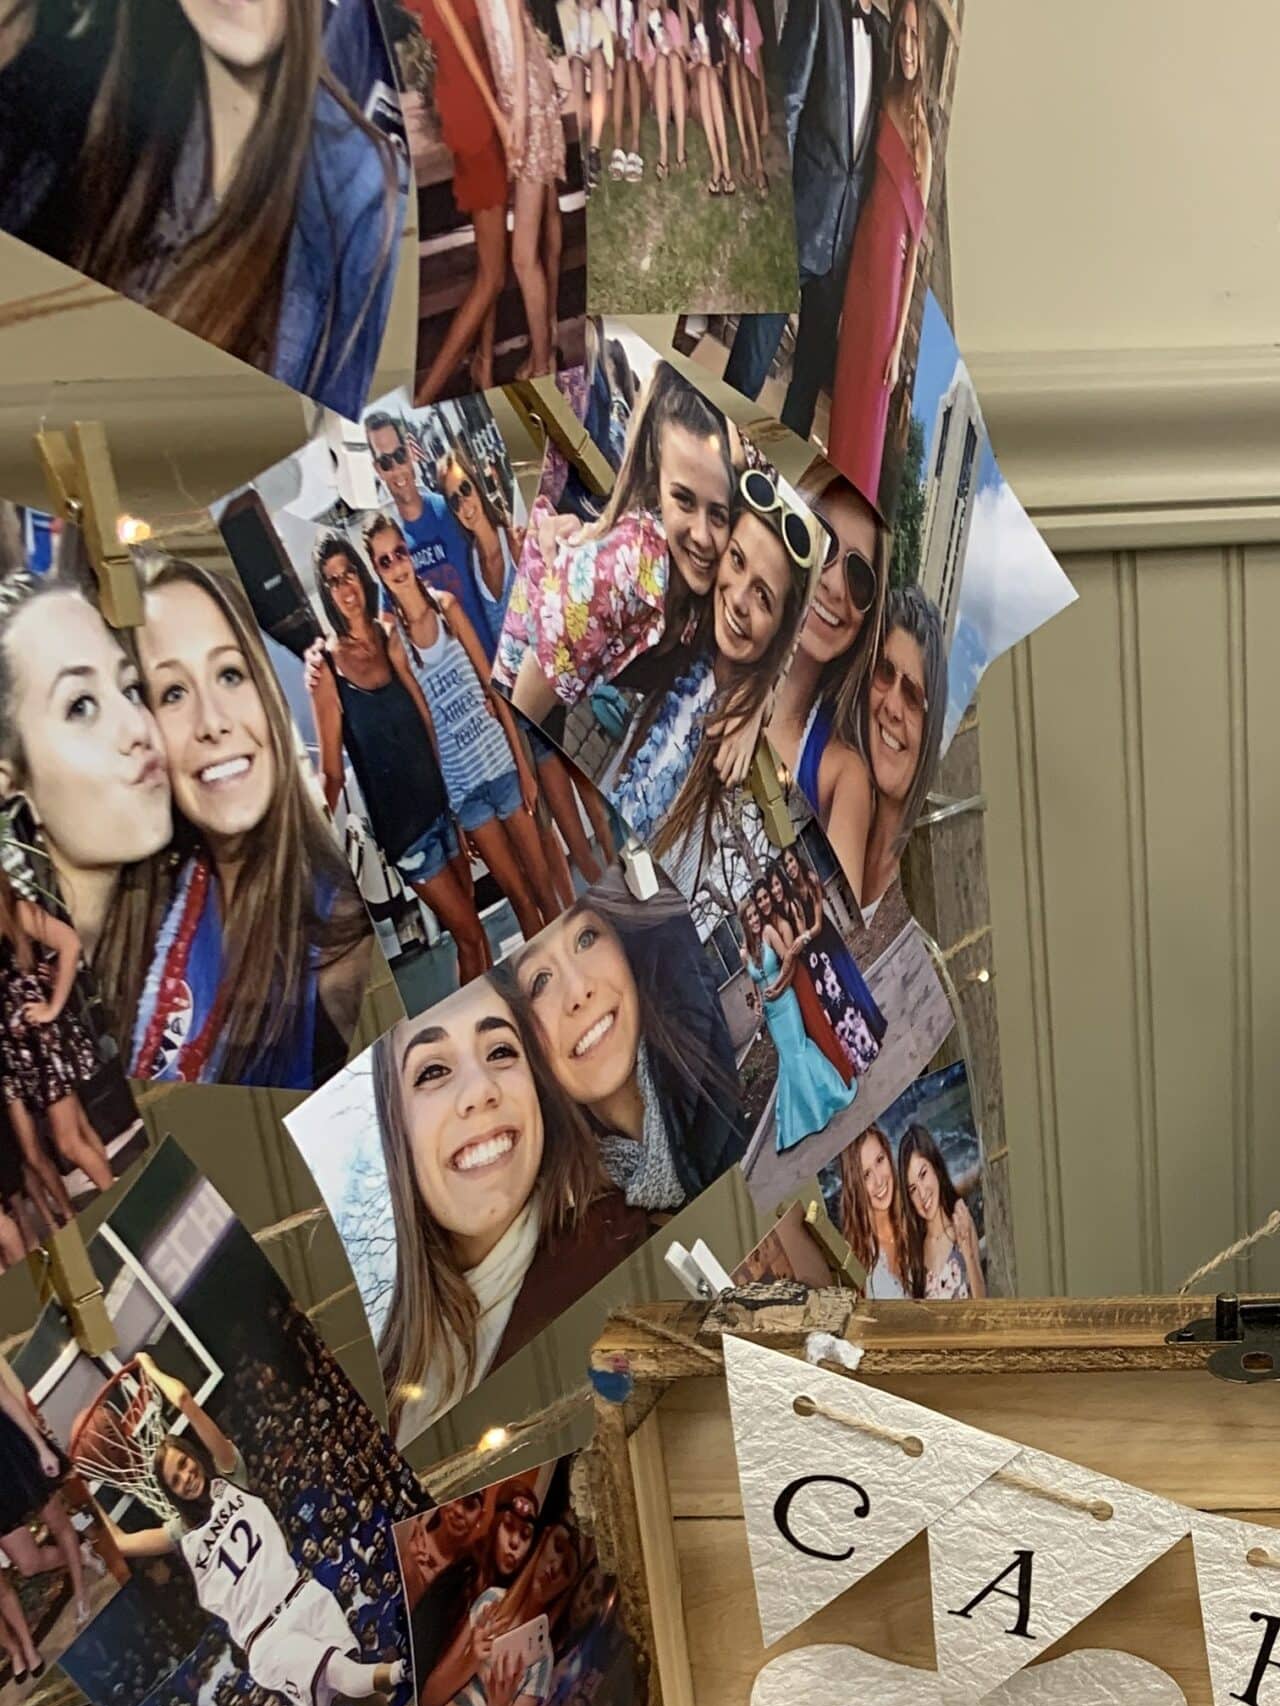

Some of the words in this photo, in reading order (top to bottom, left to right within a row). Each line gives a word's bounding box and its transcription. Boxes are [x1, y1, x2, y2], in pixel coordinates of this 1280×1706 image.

[149, 1178, 236, 1297] SCH
[195, 1494, 246, 1570] KANSAS
[216, 1518, 264, 1587] 12
